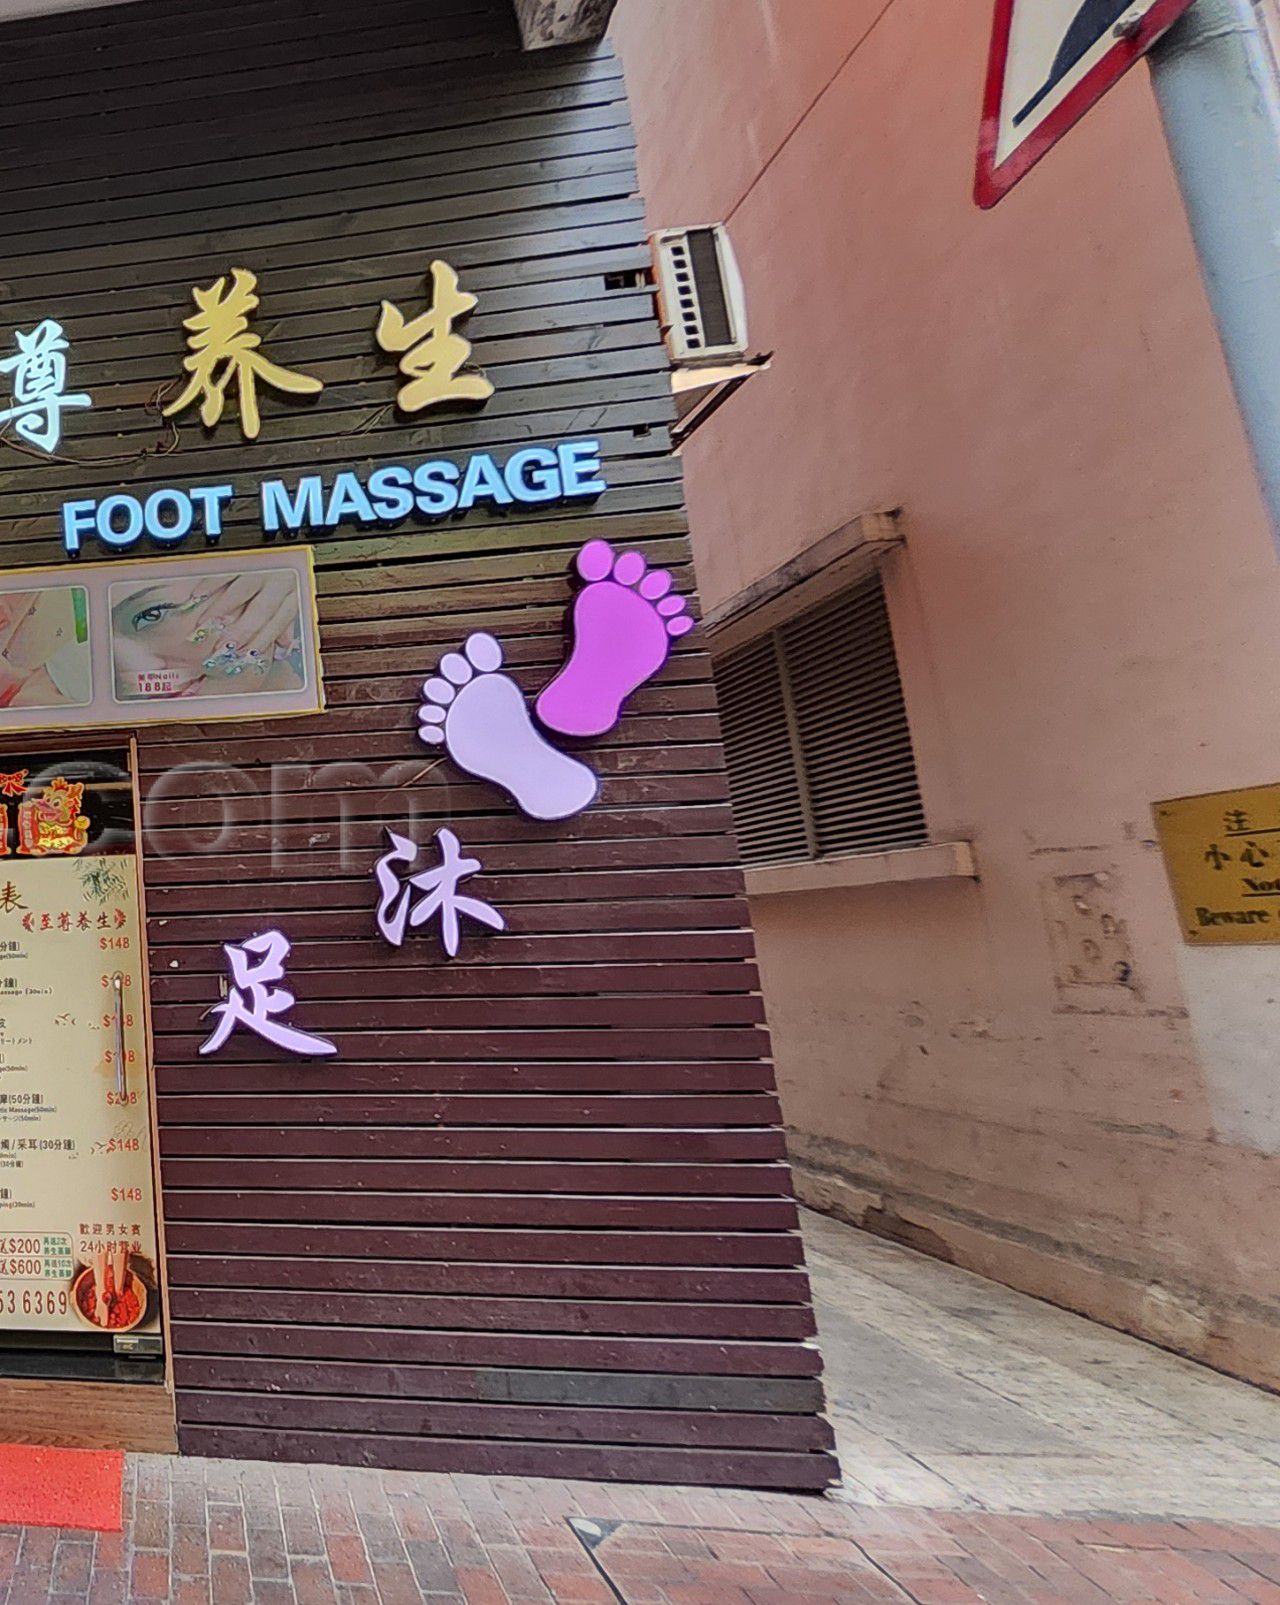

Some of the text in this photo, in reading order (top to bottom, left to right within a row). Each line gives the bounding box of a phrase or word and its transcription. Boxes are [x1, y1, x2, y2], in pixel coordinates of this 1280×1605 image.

[61, 438, 607, 555] FOOT MASSAGE
[99, 937, 130, 950] $148
[108, 1137, 140, 1152] $148
[111, 1187, 142, 1202] $148
[23, 1290, 68, 1315] 6369
